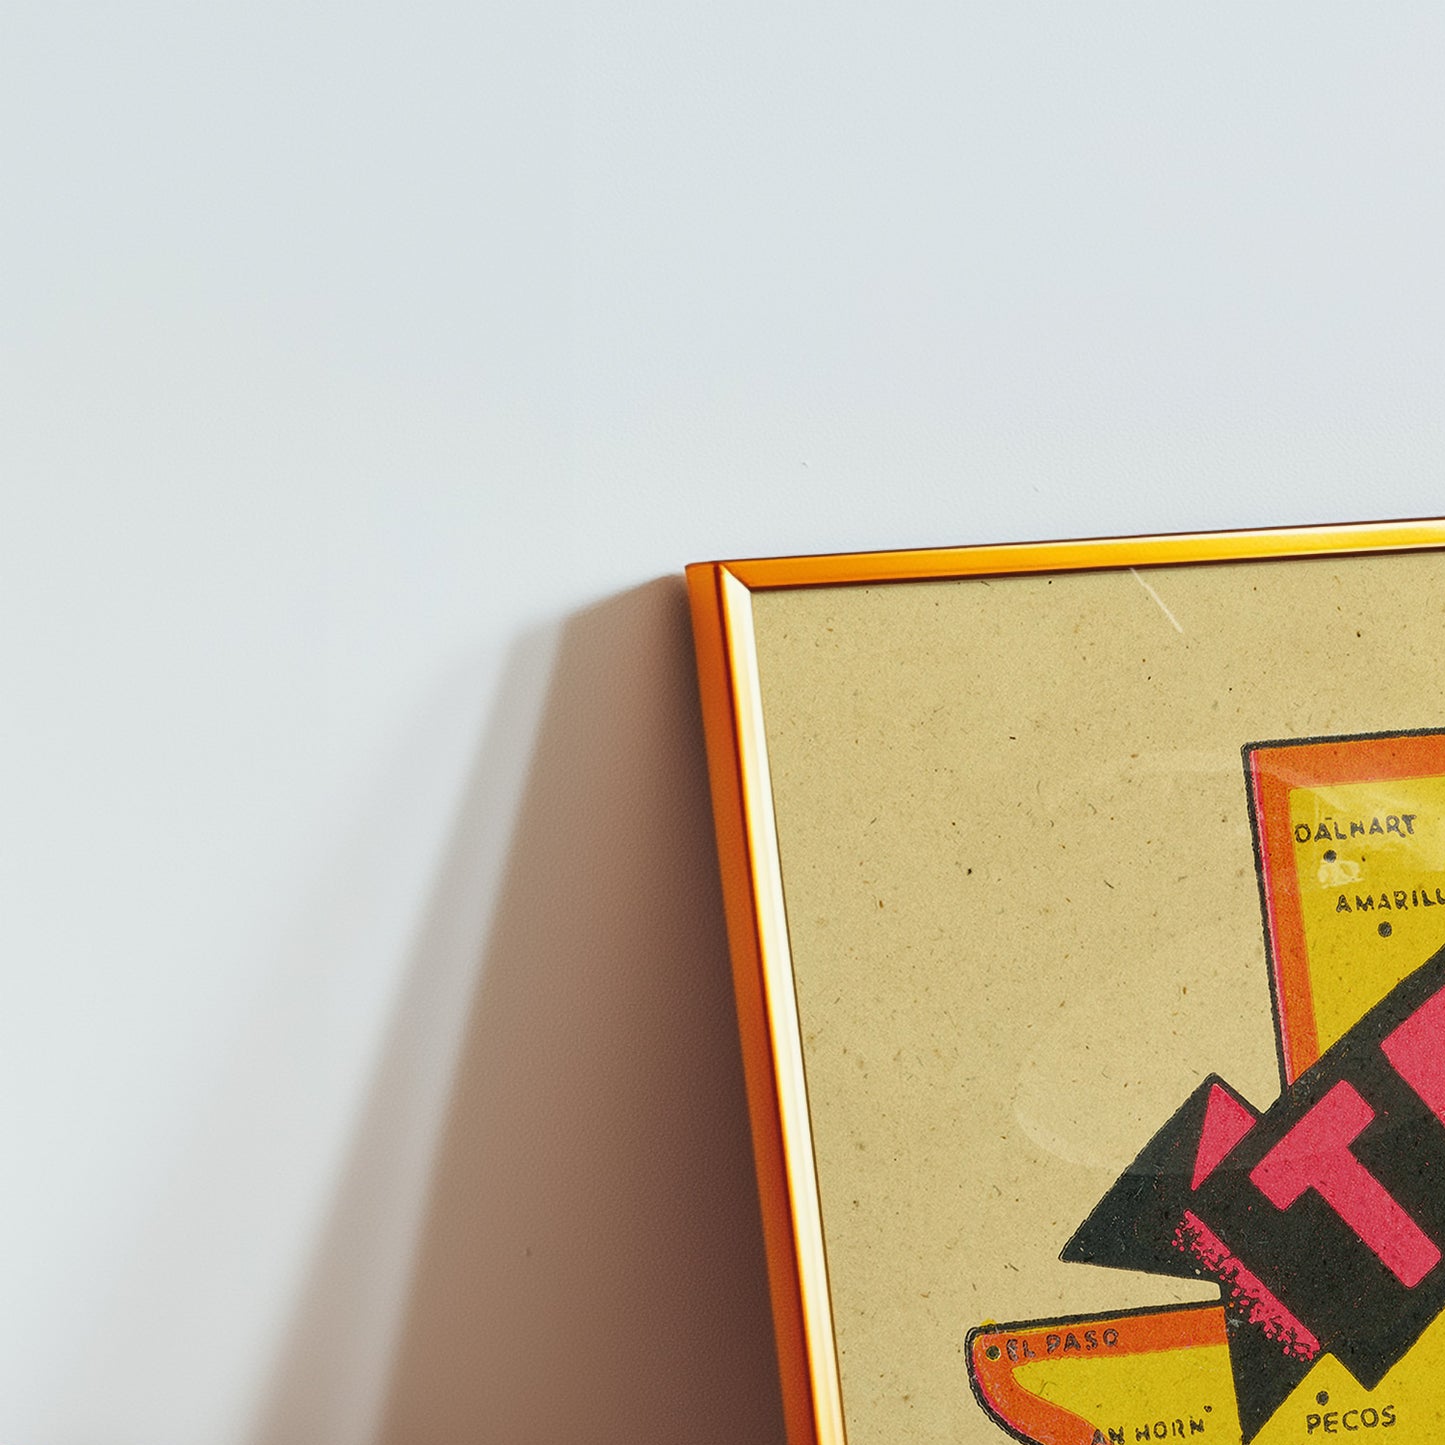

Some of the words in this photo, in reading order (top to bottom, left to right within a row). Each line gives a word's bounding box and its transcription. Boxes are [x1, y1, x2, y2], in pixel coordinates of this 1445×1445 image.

[1046, 1328, 1119, 1353] PASO
[1135, 1418, 1205, 1443] HORN
[1307, 1405, 1397, 1434] PECOS
